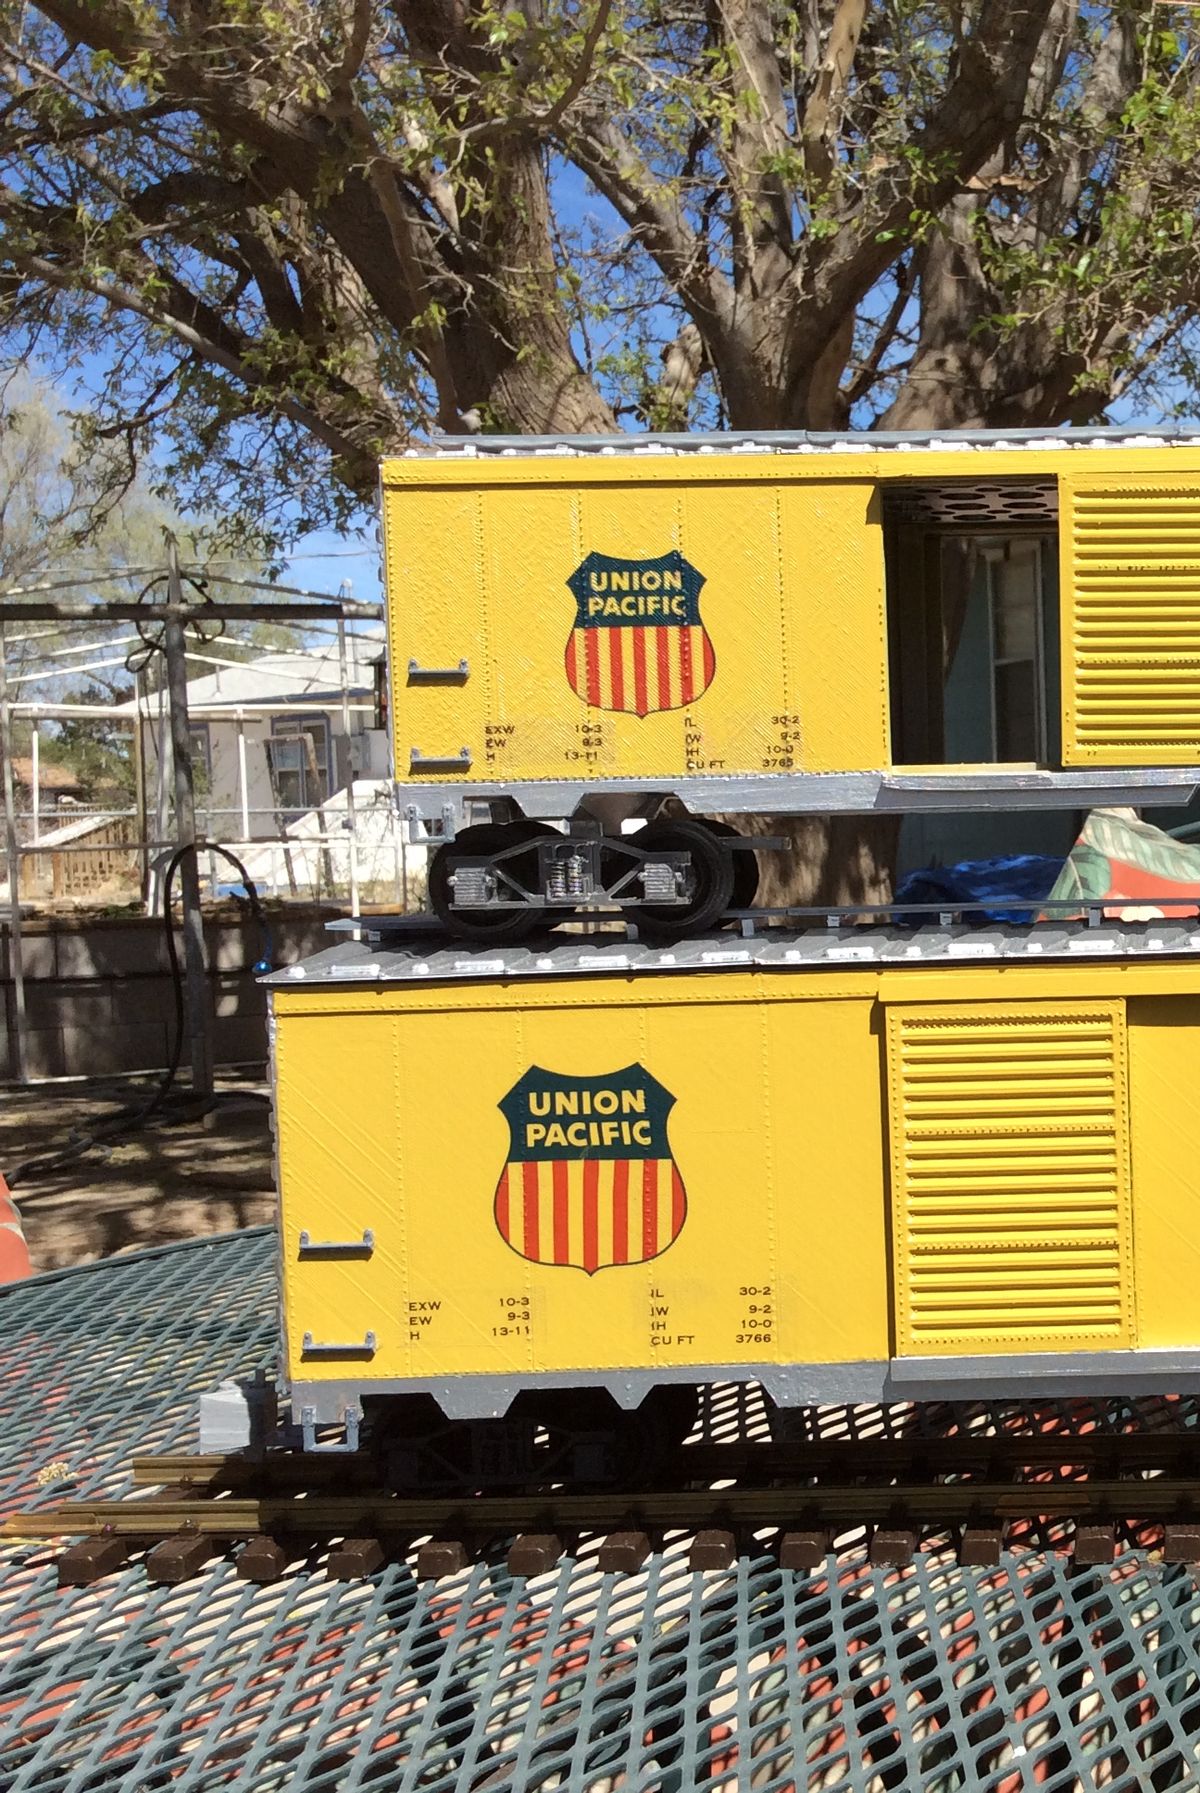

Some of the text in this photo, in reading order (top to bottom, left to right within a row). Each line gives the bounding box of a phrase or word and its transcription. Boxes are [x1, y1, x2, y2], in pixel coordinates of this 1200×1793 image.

[588, 569, 683, 591] UNION
[587, 594, 686, 617] PACIFIC
[485, 724, 602, 735] EXW 10-3
[709, 760, 726, 769] FT
[528, 1088, 646, 1117] UNION
[526, 1120, 651, 1148] PACIFIC
[739, 1286, 772, 1296] 30-2
[409, 1297, 530, 1311] EXW 10-3
[748, 1304, 772, 1314] 9-2
[409, 1311, 530, 1325] EW 9-3
[741, 1319, 772, 1329] 10-0
[410, 1326, 530, 1340] H 13-11
[650, 1333, 772, 1347] CU FT 3766
